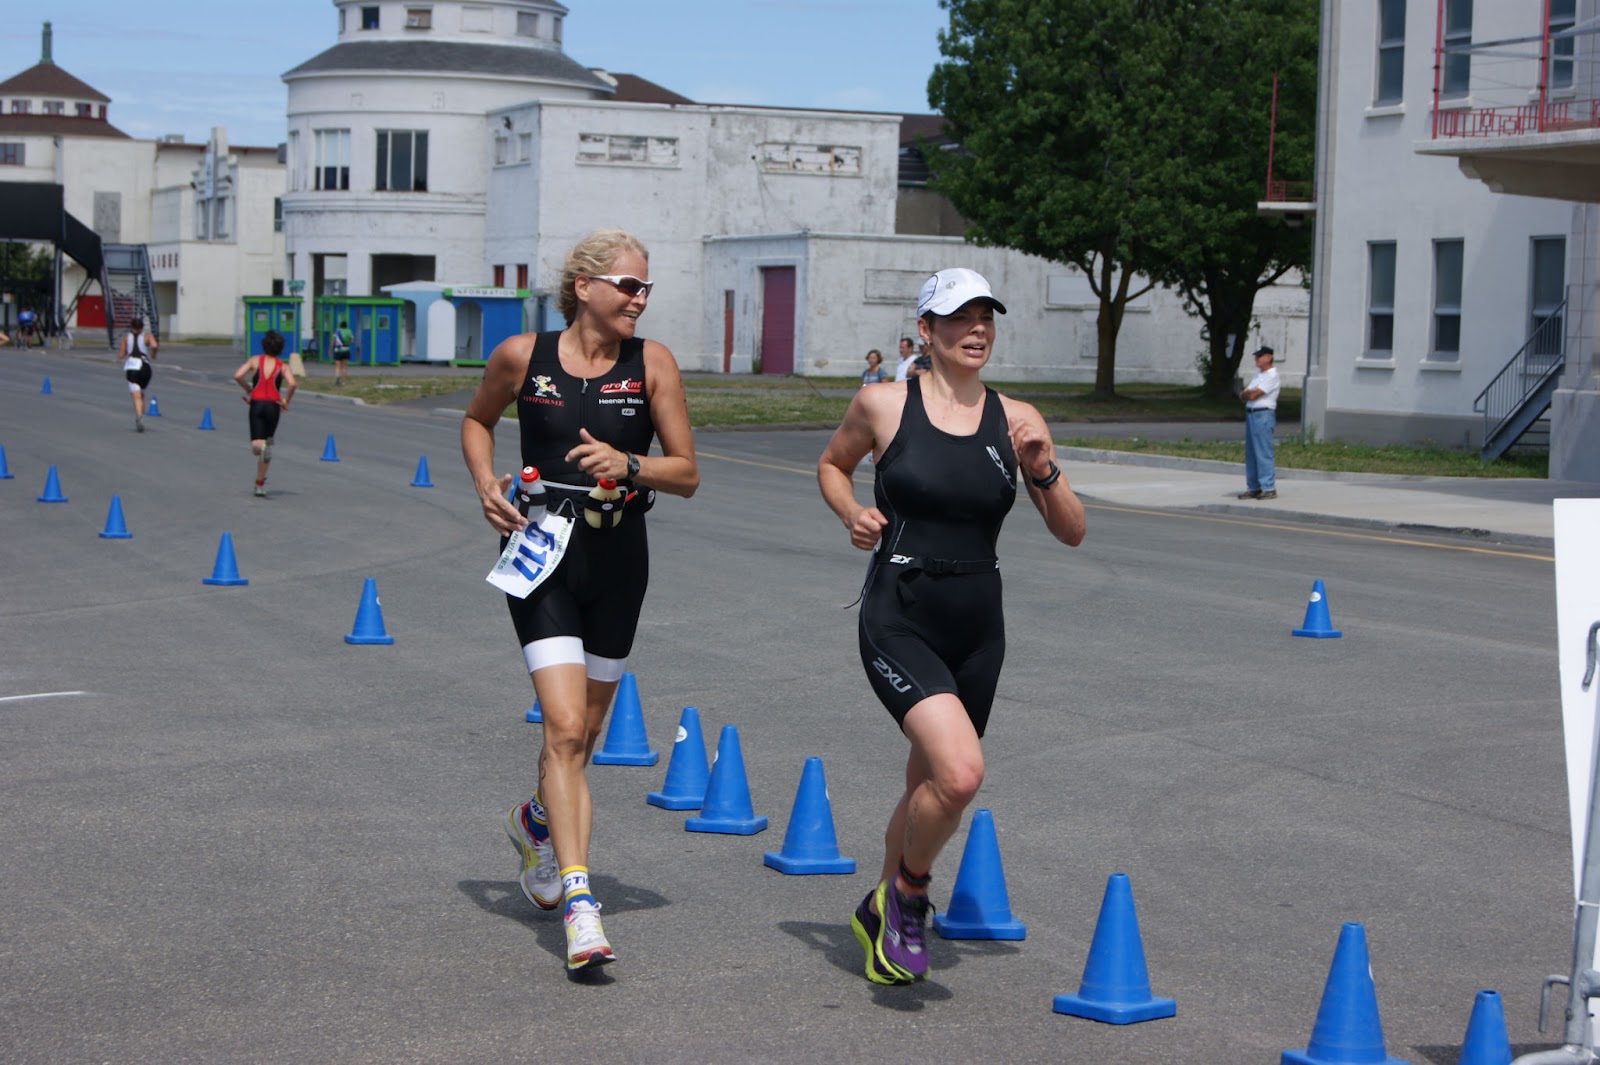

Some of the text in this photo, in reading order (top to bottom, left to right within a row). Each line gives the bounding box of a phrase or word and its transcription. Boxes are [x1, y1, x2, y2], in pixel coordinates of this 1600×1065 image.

[453, 288, 516, 296] INFORMATION
[511, 521, 556, 583] 617
[872, 656, 912, 693] 2XU
